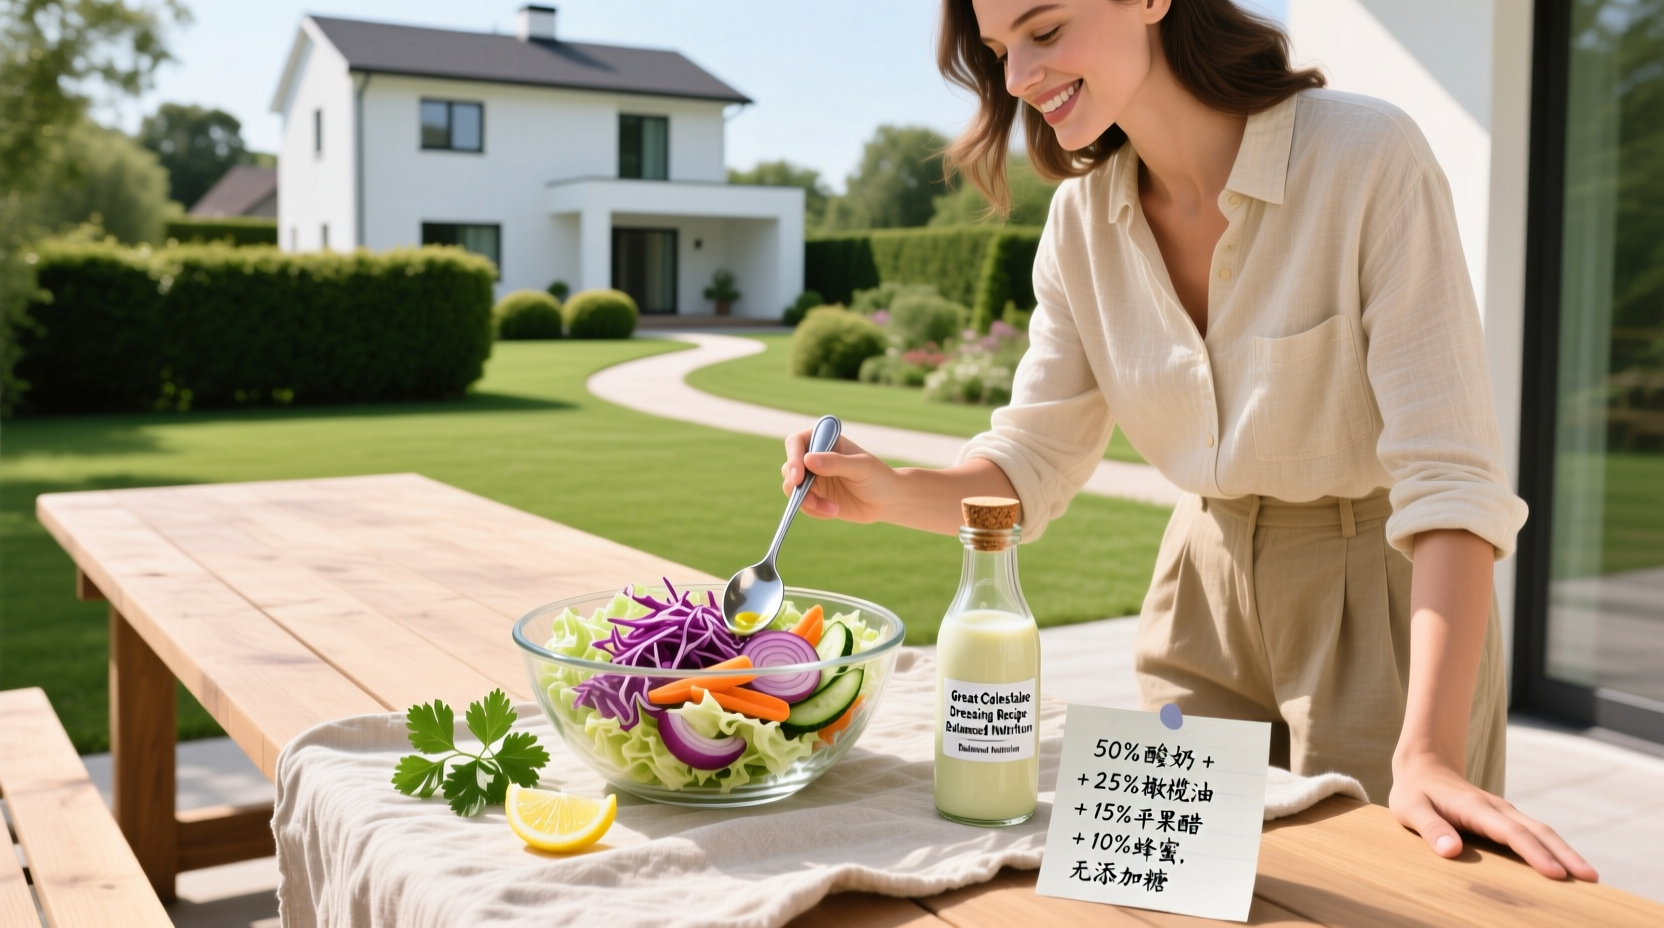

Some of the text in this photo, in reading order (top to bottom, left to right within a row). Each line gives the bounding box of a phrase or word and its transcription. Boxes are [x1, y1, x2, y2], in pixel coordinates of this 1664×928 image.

[952, 690, 978, 704] Great
[1070, 861, 1168, 892] 无添加糖
